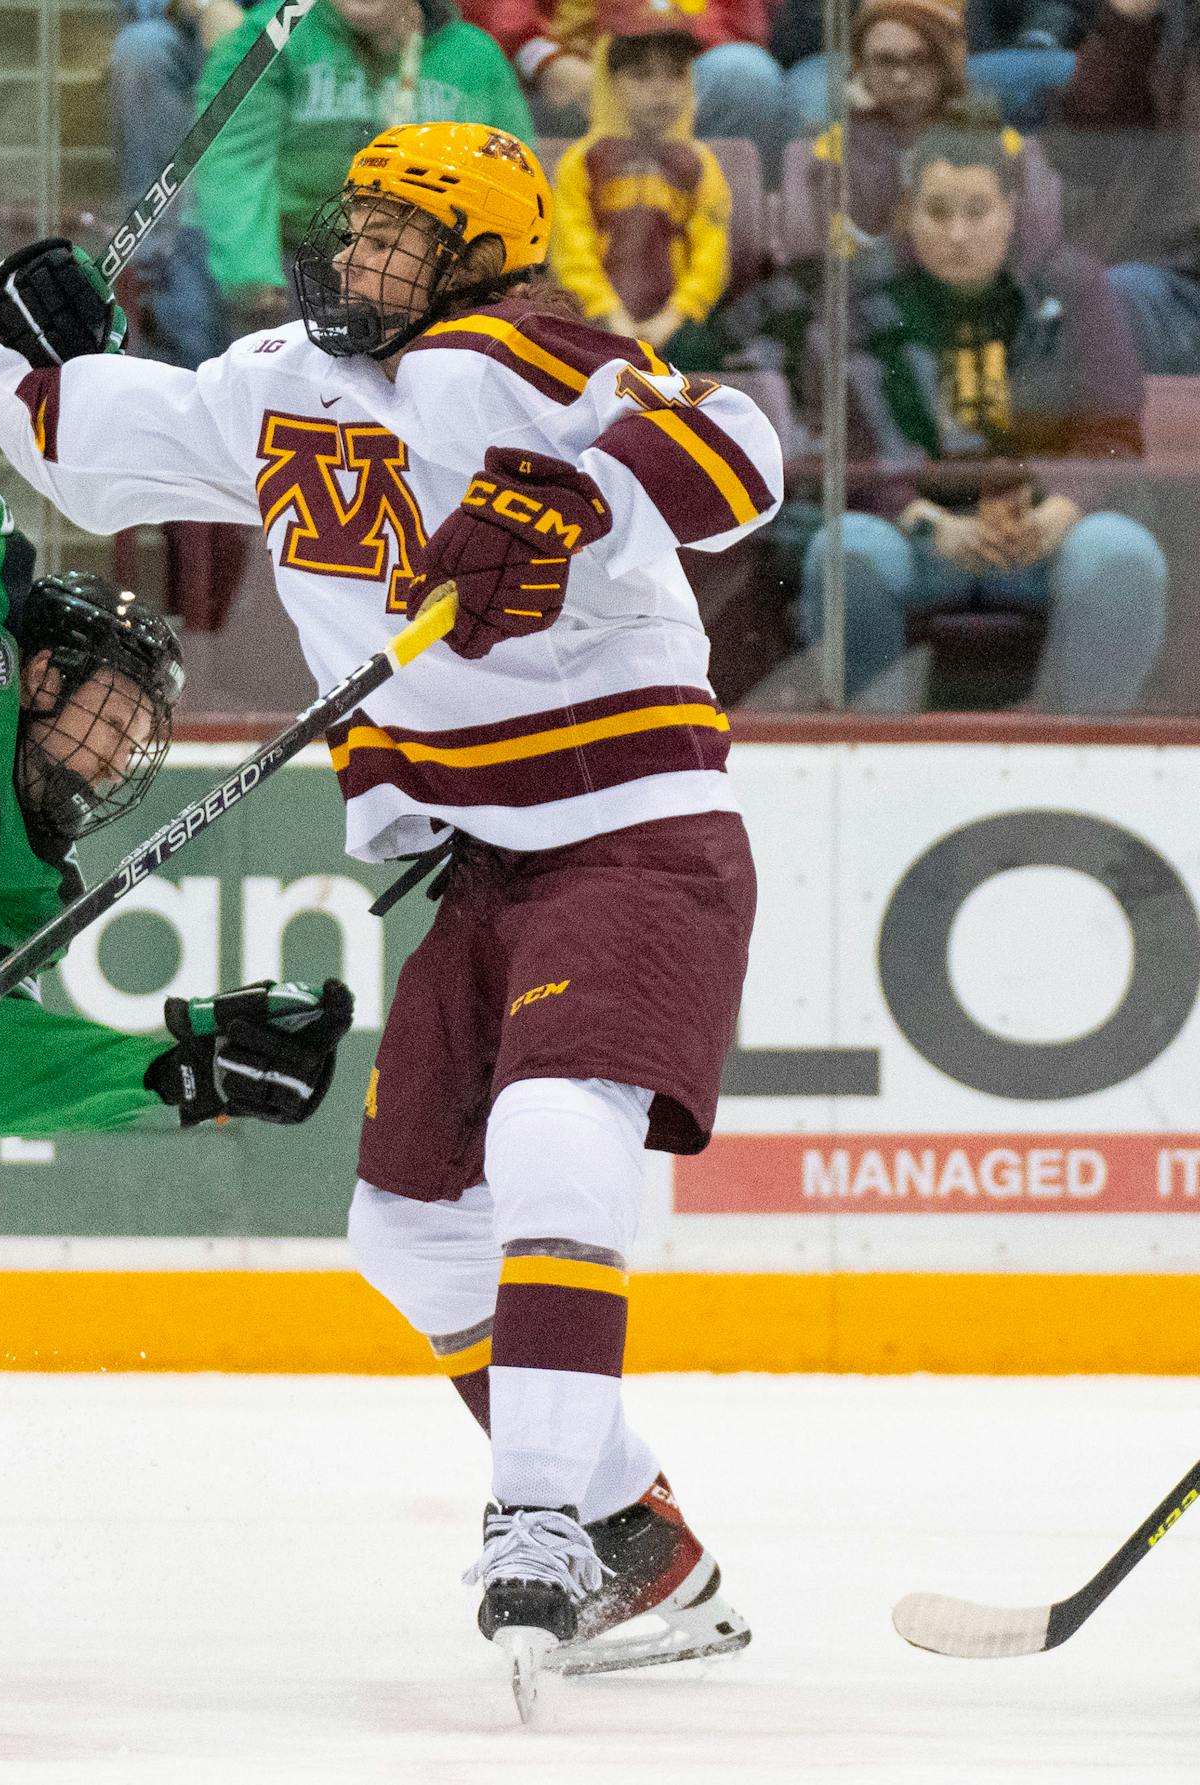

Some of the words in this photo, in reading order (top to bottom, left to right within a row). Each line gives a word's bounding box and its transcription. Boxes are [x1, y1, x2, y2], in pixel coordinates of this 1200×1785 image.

[100, 162, 178, 278] JETSP
[462, 479, 582, 549] CCM
[113, 763, 261, 899] JETSPEED
[510, 979, 571, 1017] CCM
[801, 1148, 1108, 1198] MANAGED
